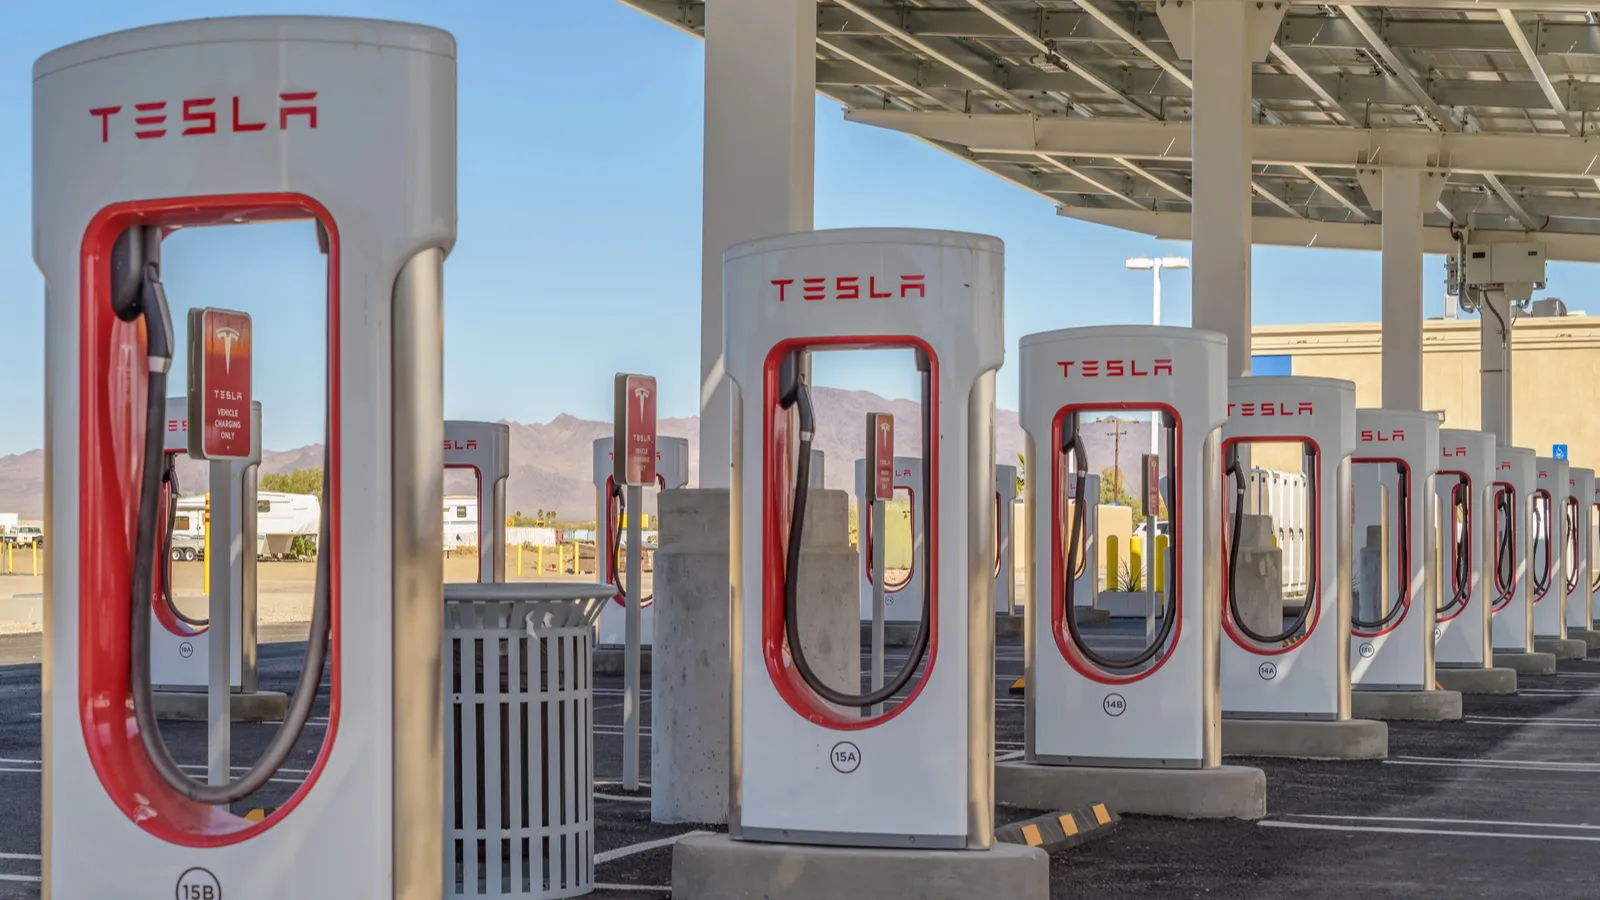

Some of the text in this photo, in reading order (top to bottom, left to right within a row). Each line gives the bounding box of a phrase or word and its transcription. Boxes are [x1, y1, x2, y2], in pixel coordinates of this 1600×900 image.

[89, 91, 318, 142] TESLA
[770, 274, 925, 302] TESLA
[1056, 359, 1173, 378] TESLA
[214, 389, 242, 400] TESLA
[217, 408, 239, 418] VEHICLE
[214, 419, 241, 429] CHARGING
[220, 431, 235, 440] ONLY
[1361, 430, 1405, 441] SLA
[444, 439, 477, 450] SLA
[1106, 700, 1123, 709] 14B
[835, 751, 856, 762] 15A
[182, 884, 214, 900] 15B
